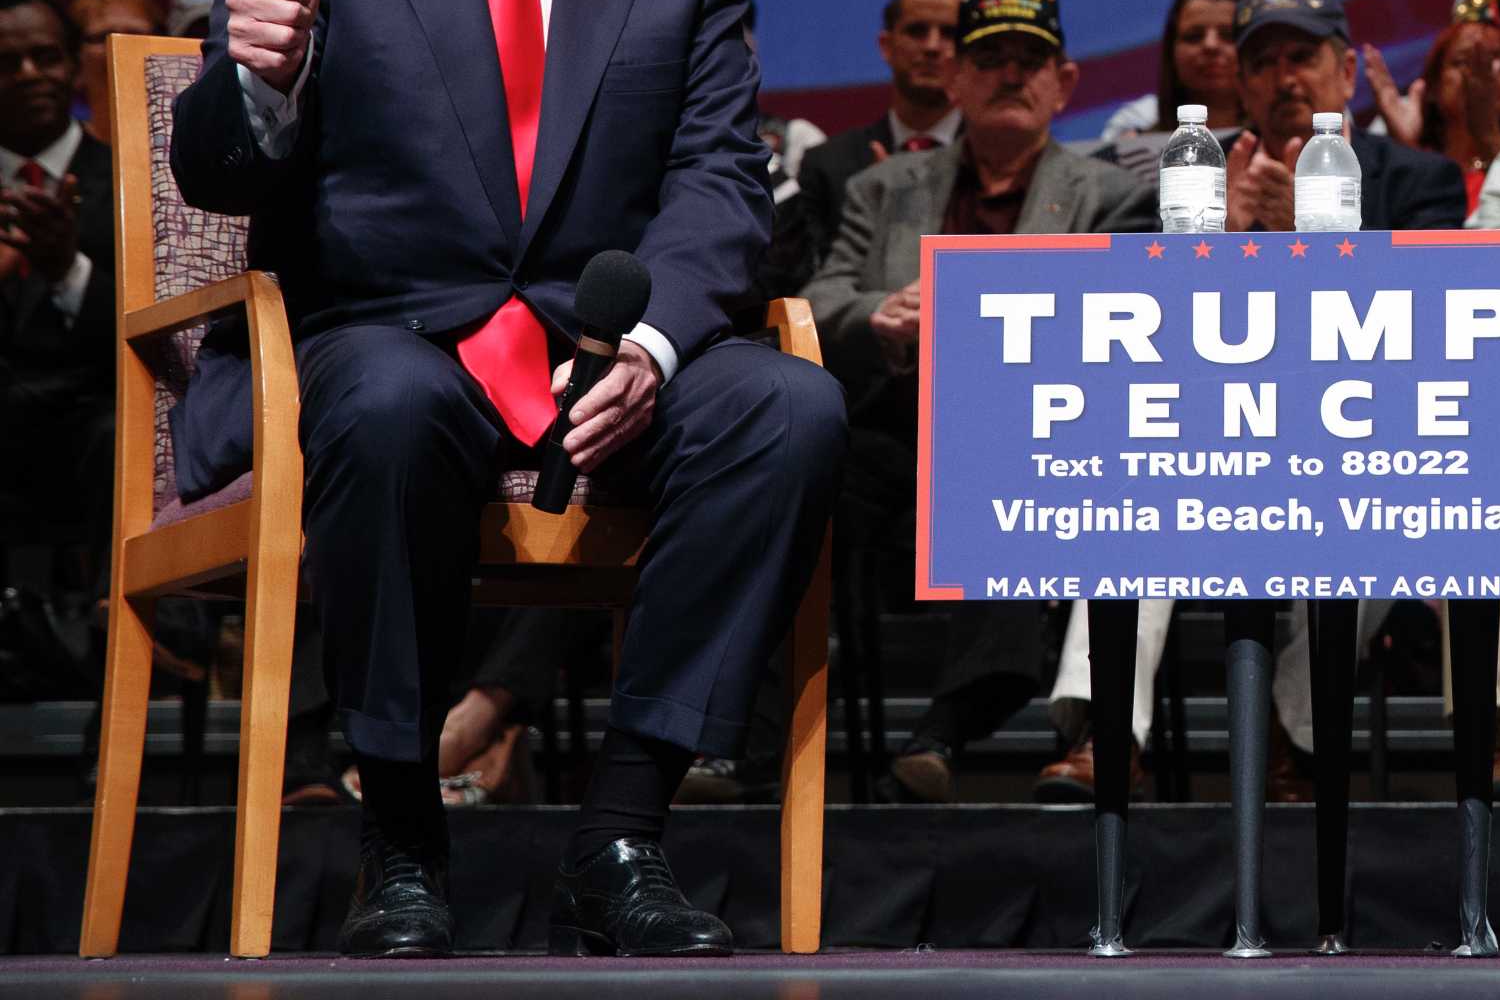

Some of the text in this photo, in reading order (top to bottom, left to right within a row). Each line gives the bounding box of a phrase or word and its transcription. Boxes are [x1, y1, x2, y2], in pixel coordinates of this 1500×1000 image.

[1032, 380, 1470, 438] PENCE
[1032, 450, 1469, 477] Text TRUMP to 88022
[992, 499, 1161, 540] Virginia
[1177, 498, 1324, 536] Beach,
[986, 577, 1081, 597] MAKE
[1094, 577, 1249, 597] AMERICA
[1265, 576, 1378, 597] GREAT
